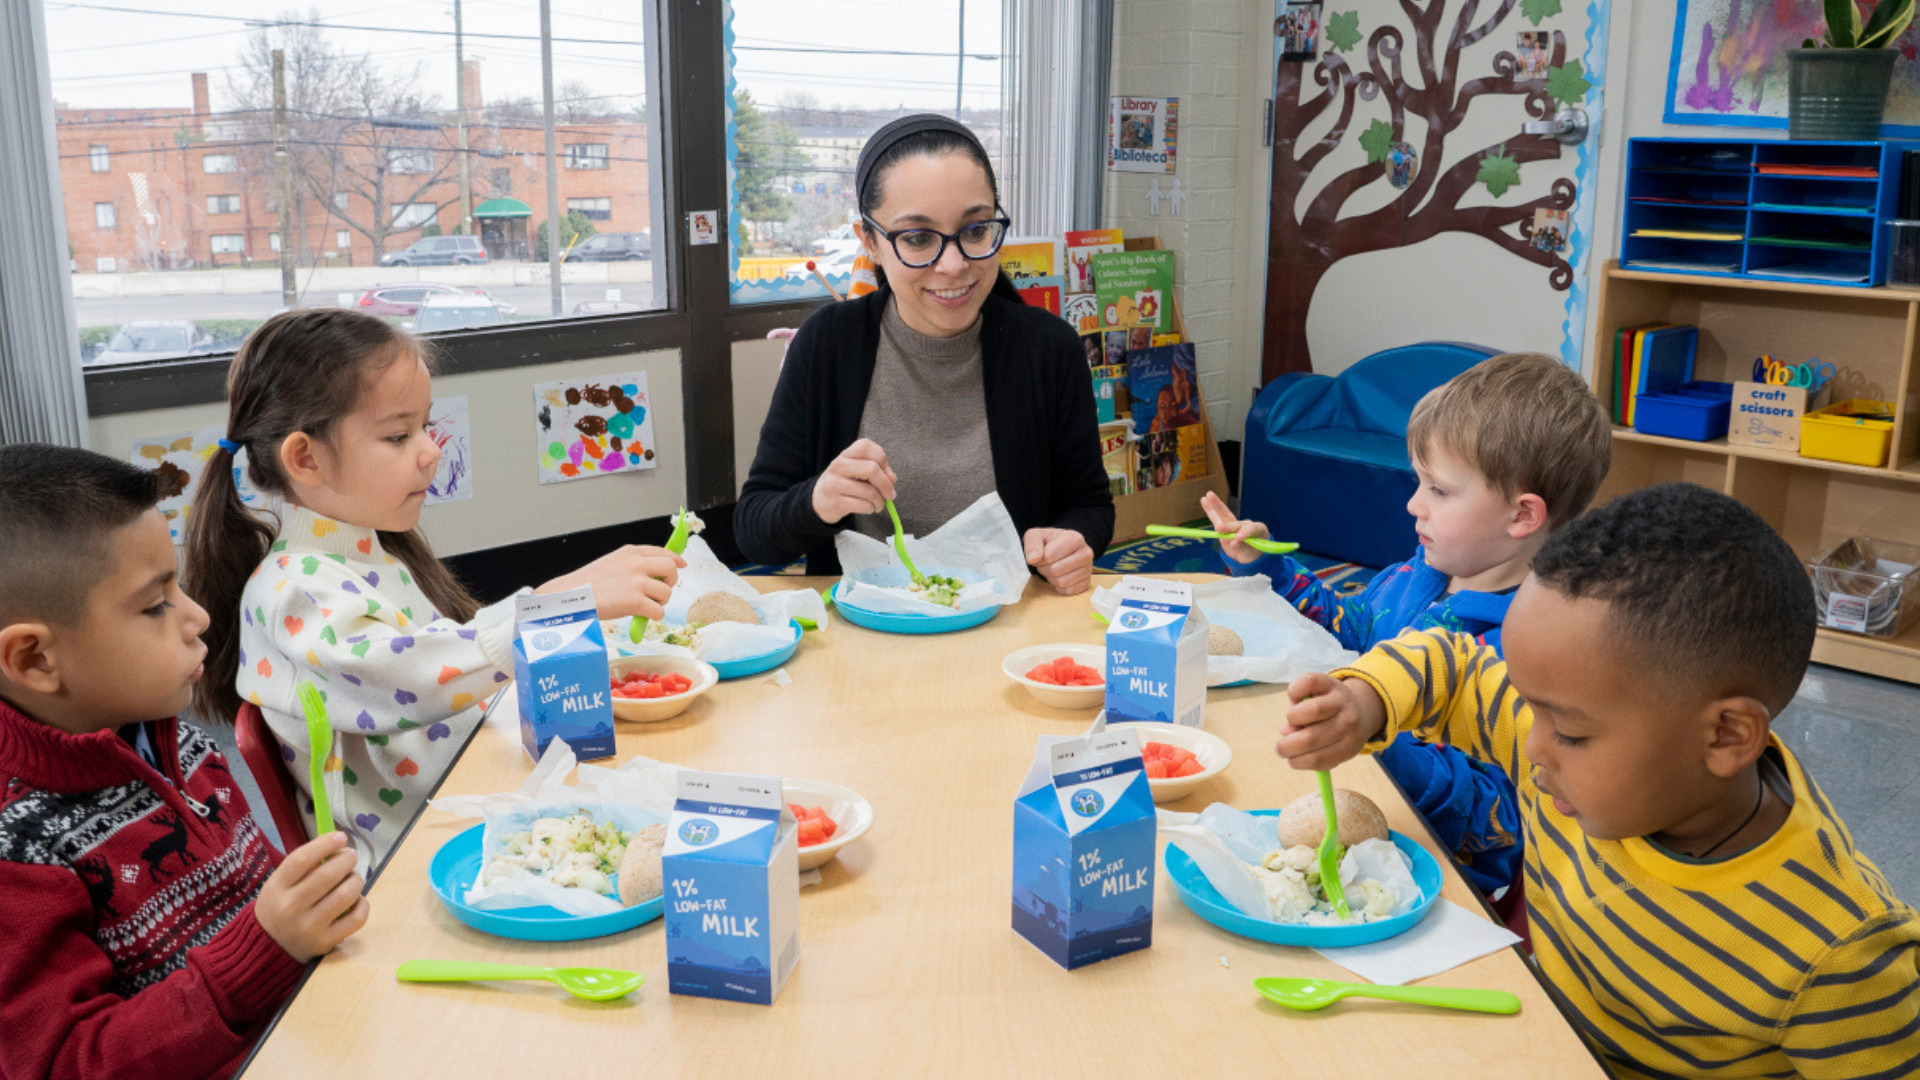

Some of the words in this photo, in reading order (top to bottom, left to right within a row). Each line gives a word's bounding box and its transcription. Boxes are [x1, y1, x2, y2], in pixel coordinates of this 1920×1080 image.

[1121, 98, 1158, 114] Library
[1113, 148, 1167, 163] Biblioteca
[1120, 256, 1134, 266] Big
[1135, 255, 1156, 264] Book
[1156, 254, 1167, 262] of
[1113, 279, 1147, 288] Numbers
[1093, 366, 1114, 379] ADES
[1751, 390, 1787, 401] craft
[1739, 402, 1794, 418] scissors
[1100, 434, 1125, 456] LES
[1114, 536, 1205, 571] MYSTER
[1111, 650, 1130, 664] 1%
[1112, 666, 1148, 676] LOW-FAT
[537, 673, 559, 692] 1%
[1129, 677, 1168, 698] MILK
[540, 683, 581, 704] LOW-FAT
[562, 691, 605, 714] MILK
[718, 806, 749, 817] LOW-FAT
[1078, 848, 1101, 872] 1%
[1079, 858, 1125, 888] LOW-FAT
[671, 878, 698, 898] 1%
[1101, 867, 1148, 898] MILK
[673, 898, 727, 913] LOW-FAT
[702, 913, 760, 938] MILK
